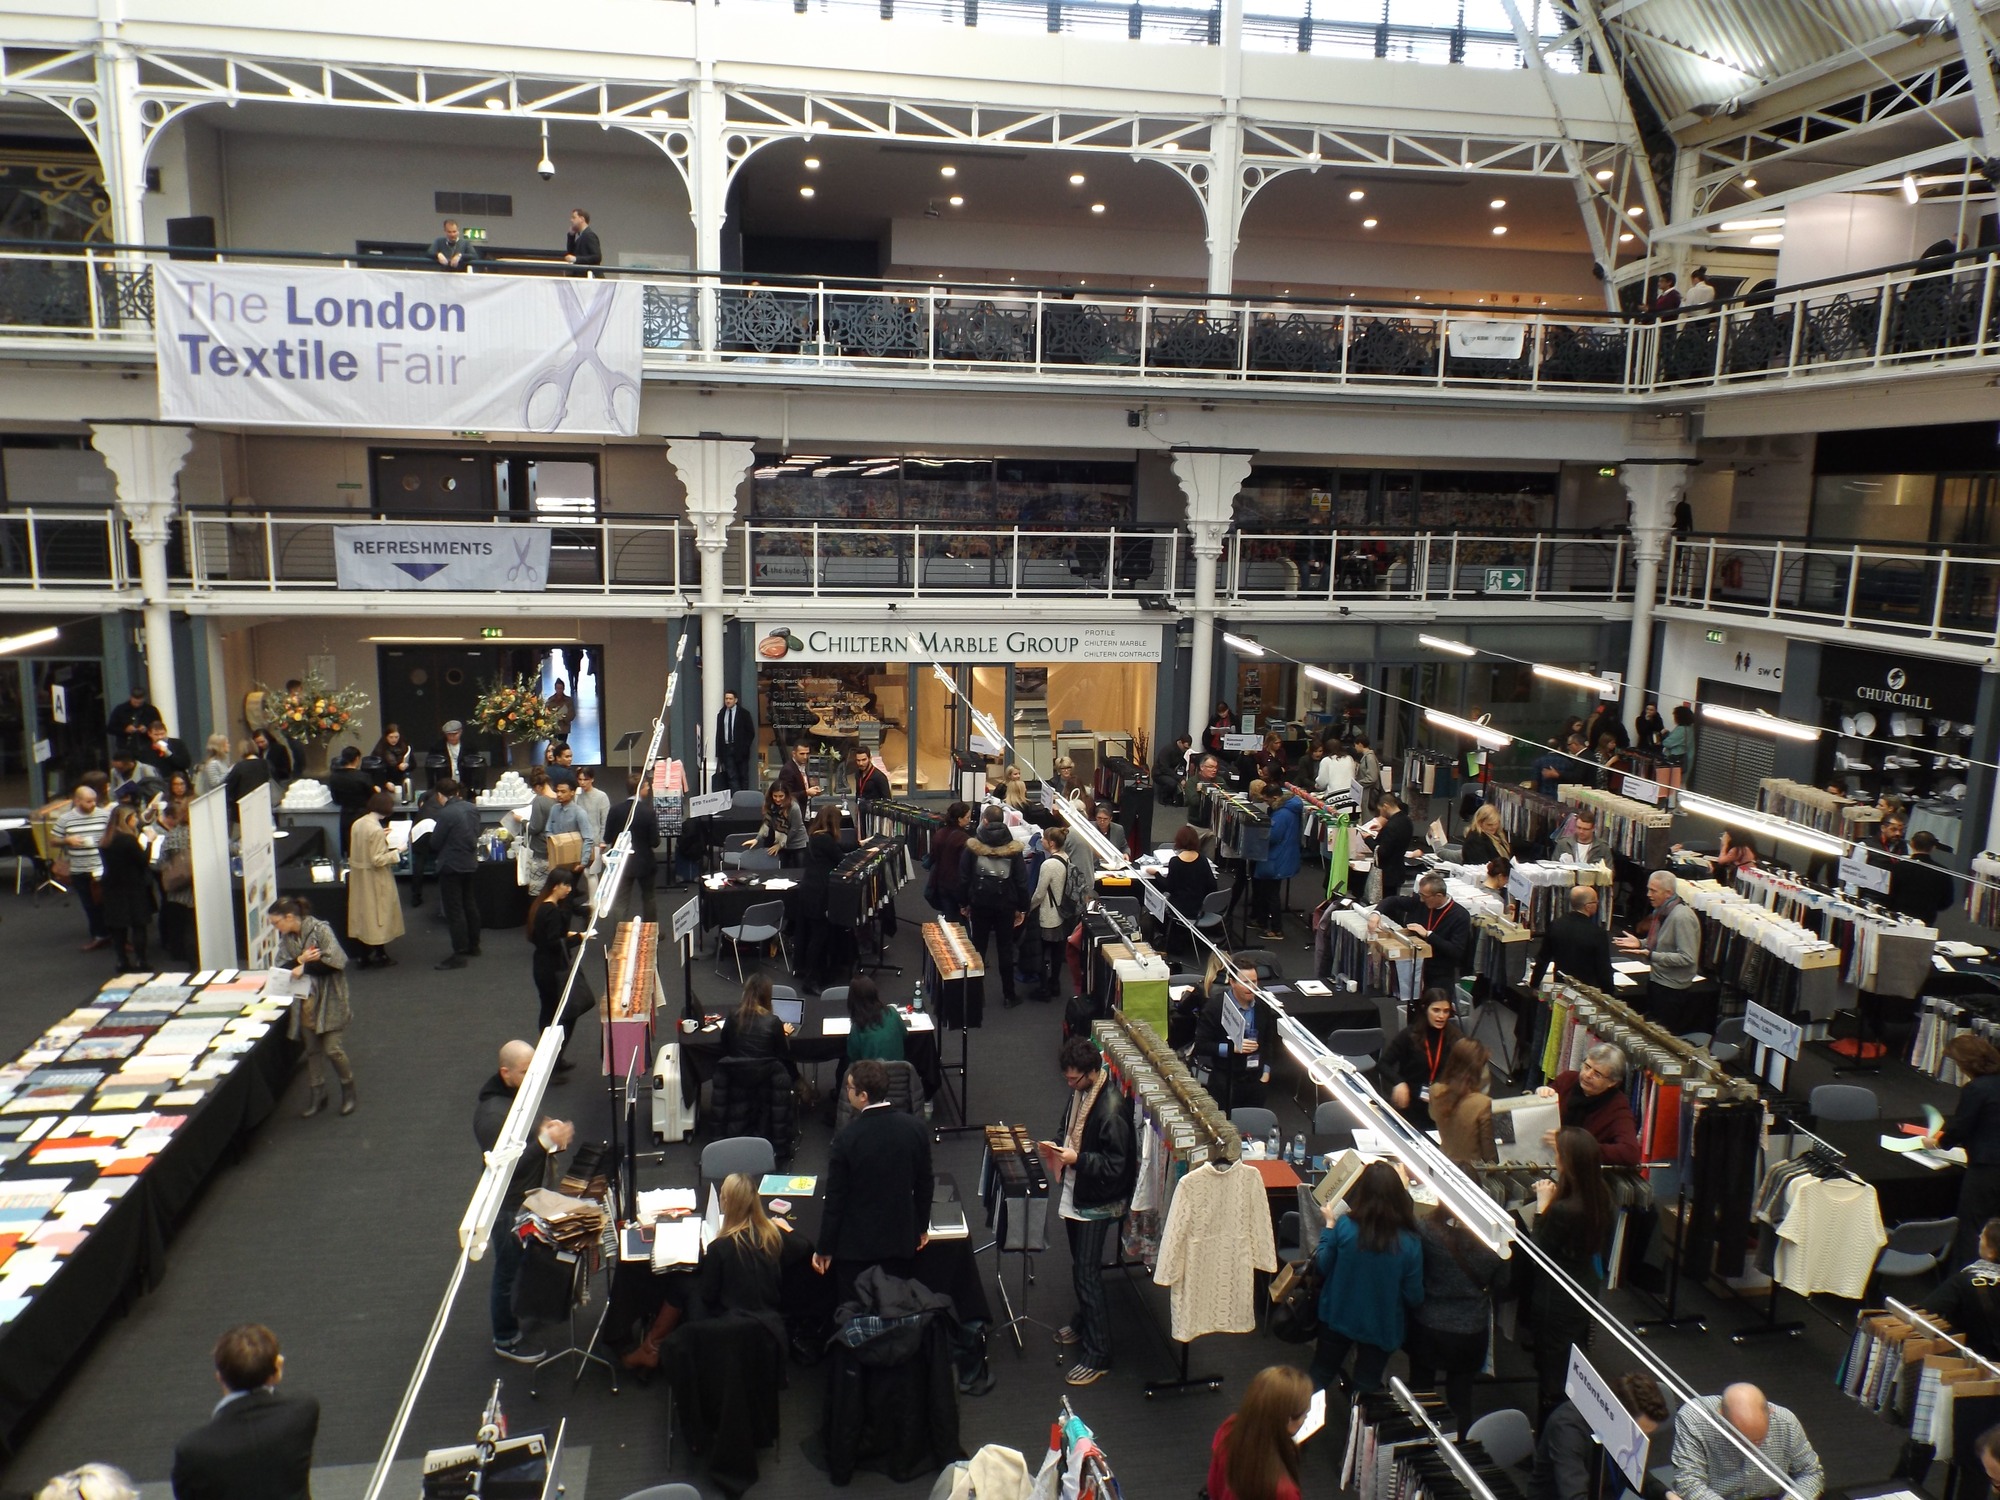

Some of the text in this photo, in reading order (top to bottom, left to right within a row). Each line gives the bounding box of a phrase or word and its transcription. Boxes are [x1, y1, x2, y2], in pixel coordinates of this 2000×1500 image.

[177, 280, 466, 332] The London
[178, 334, 466, 385] Textile Fair
[353, 541, 493, 555] REFRESHMENTS
[785, 566, 800, 576] kyte
[809, 631, 1079, 653] CHILTERN MARBLE GROUP
[773, 669, 812, 677] PROTILE
[1773, 667, 1782, 679] C
[55, 694, 64, 714] A
[1573, 1361, 1615, 1421] Kotonteks
